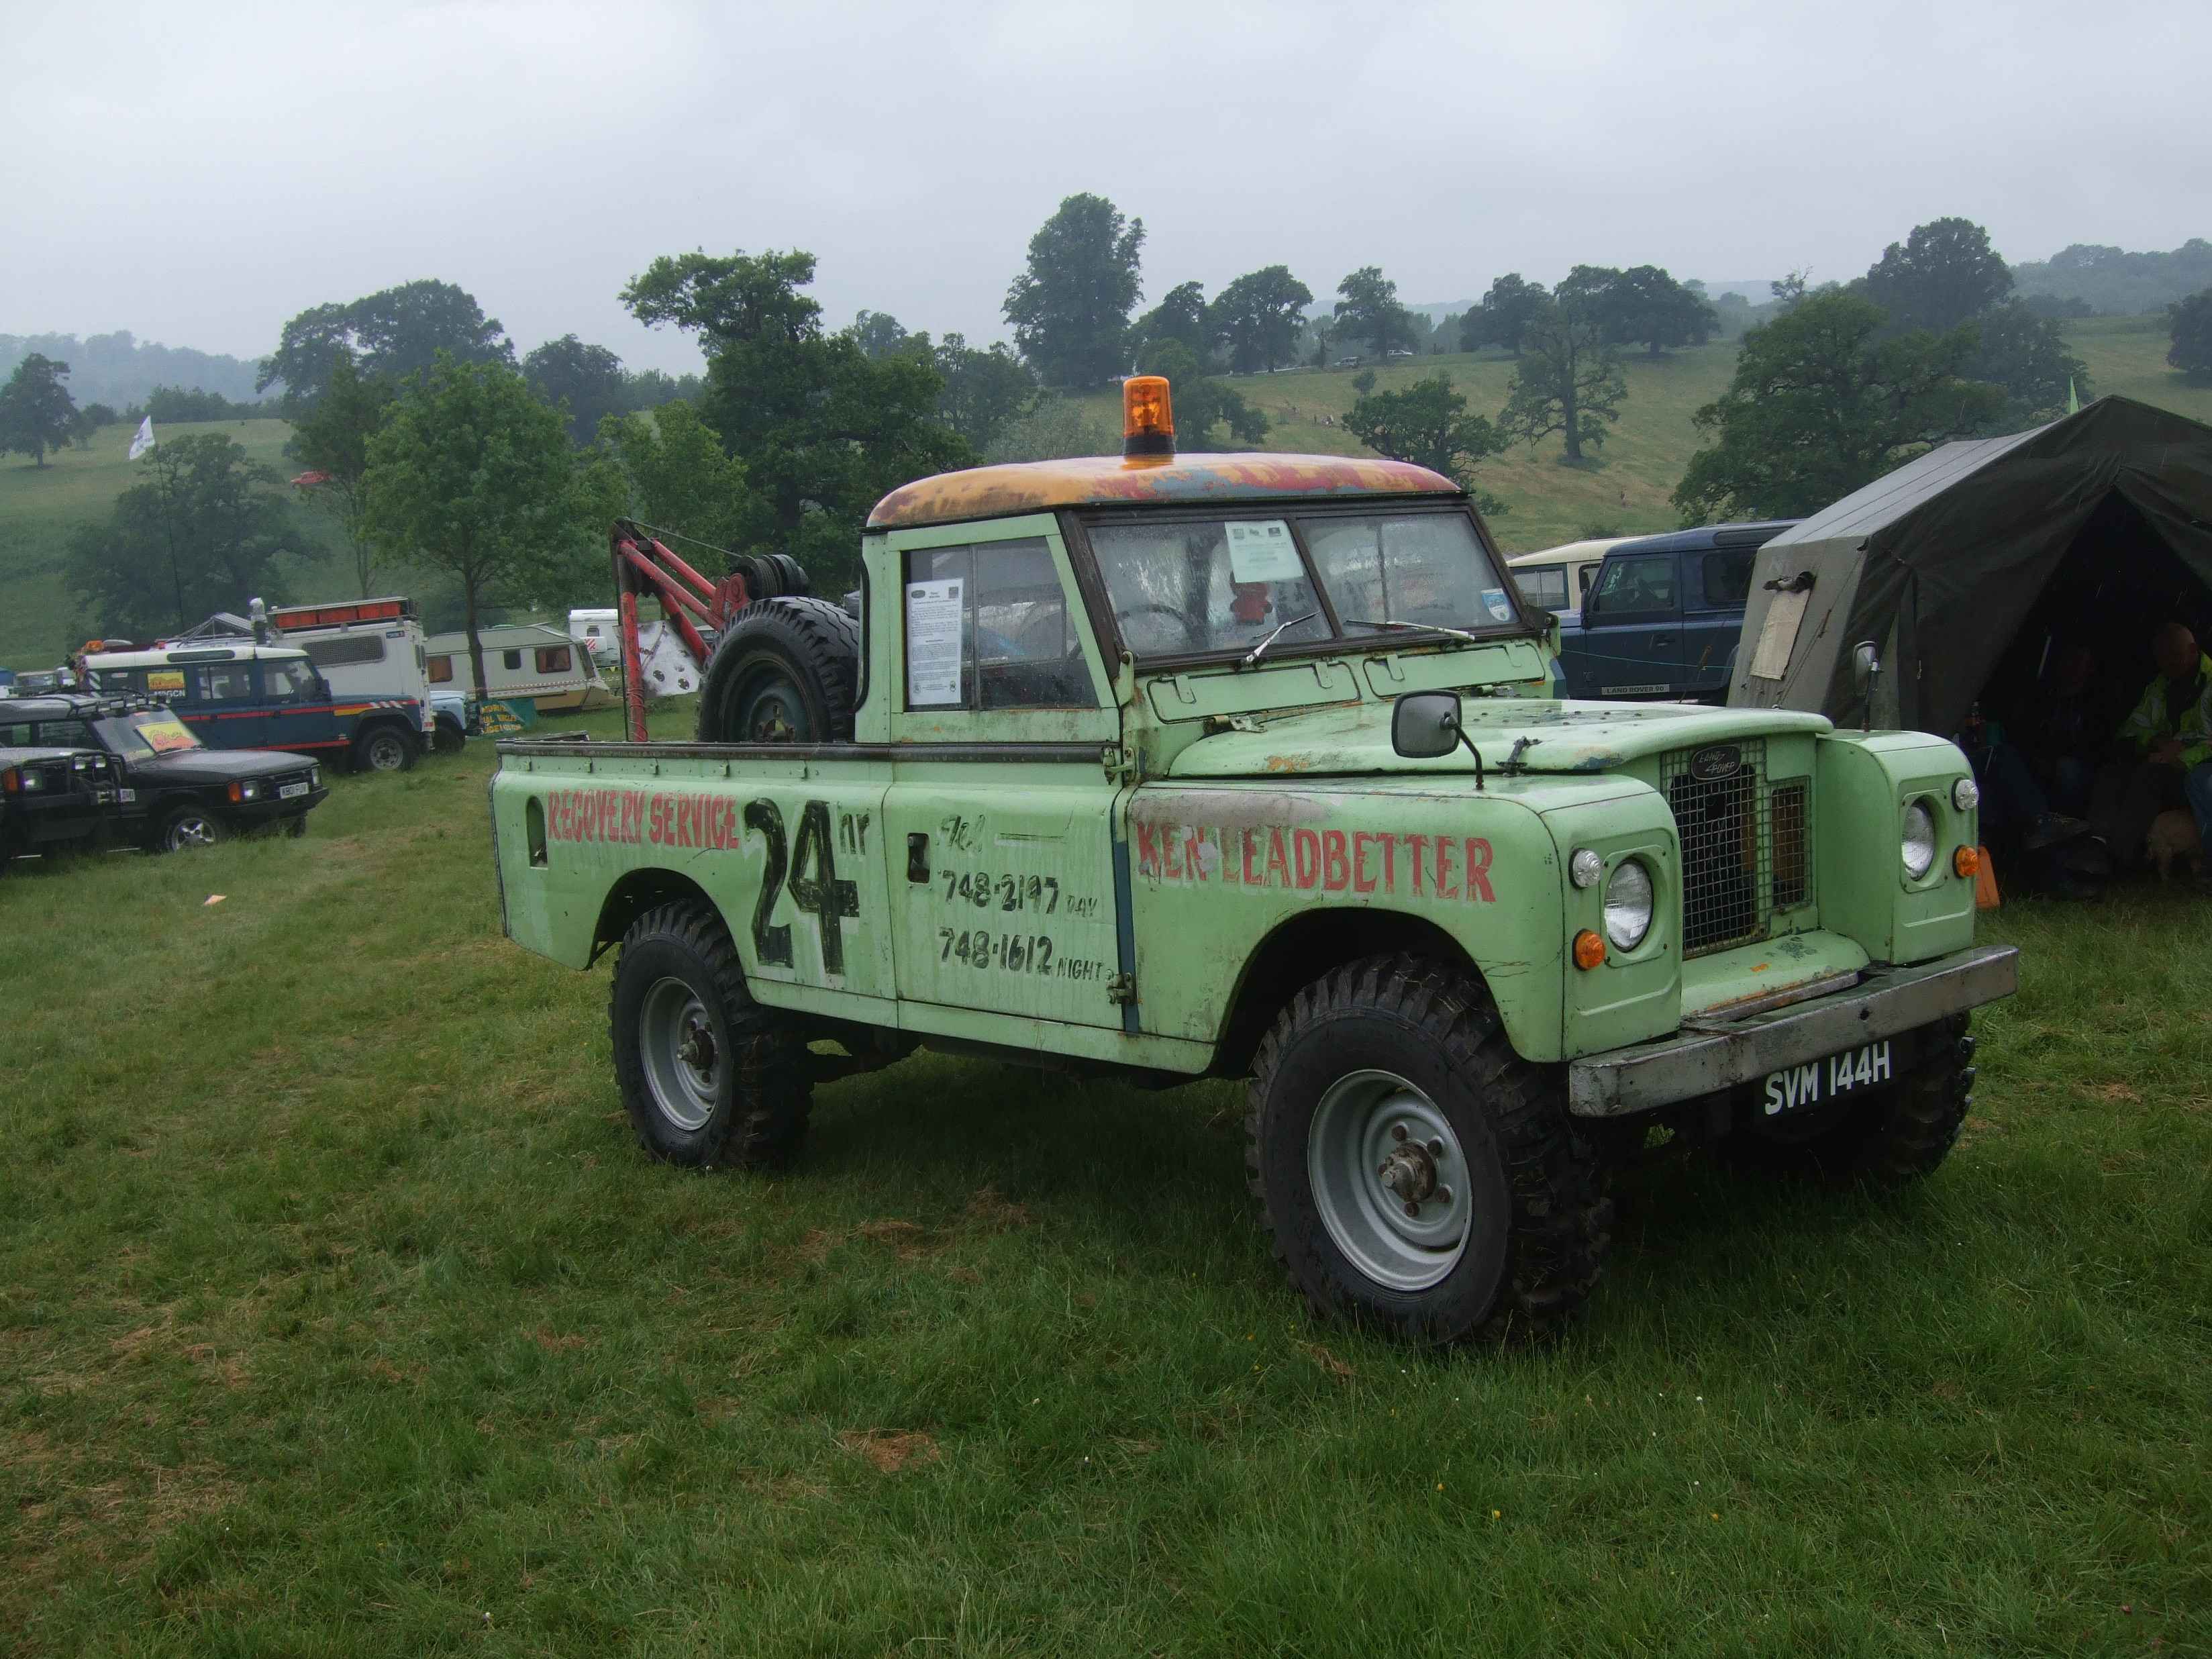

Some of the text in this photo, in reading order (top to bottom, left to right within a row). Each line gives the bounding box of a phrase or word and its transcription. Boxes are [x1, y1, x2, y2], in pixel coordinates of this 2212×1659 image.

[548, 789, 646, 844] RECOVERY
[650, 793, 740, 850] SERVICE
[1138, 823, 1497, 903] KEN LEADBETTER
[1067, 895, 1099, 918] DAY
[1057, 958, 1103, 981] NIGHT
[1764, 1040, 1891, 1115] SVM 144H
